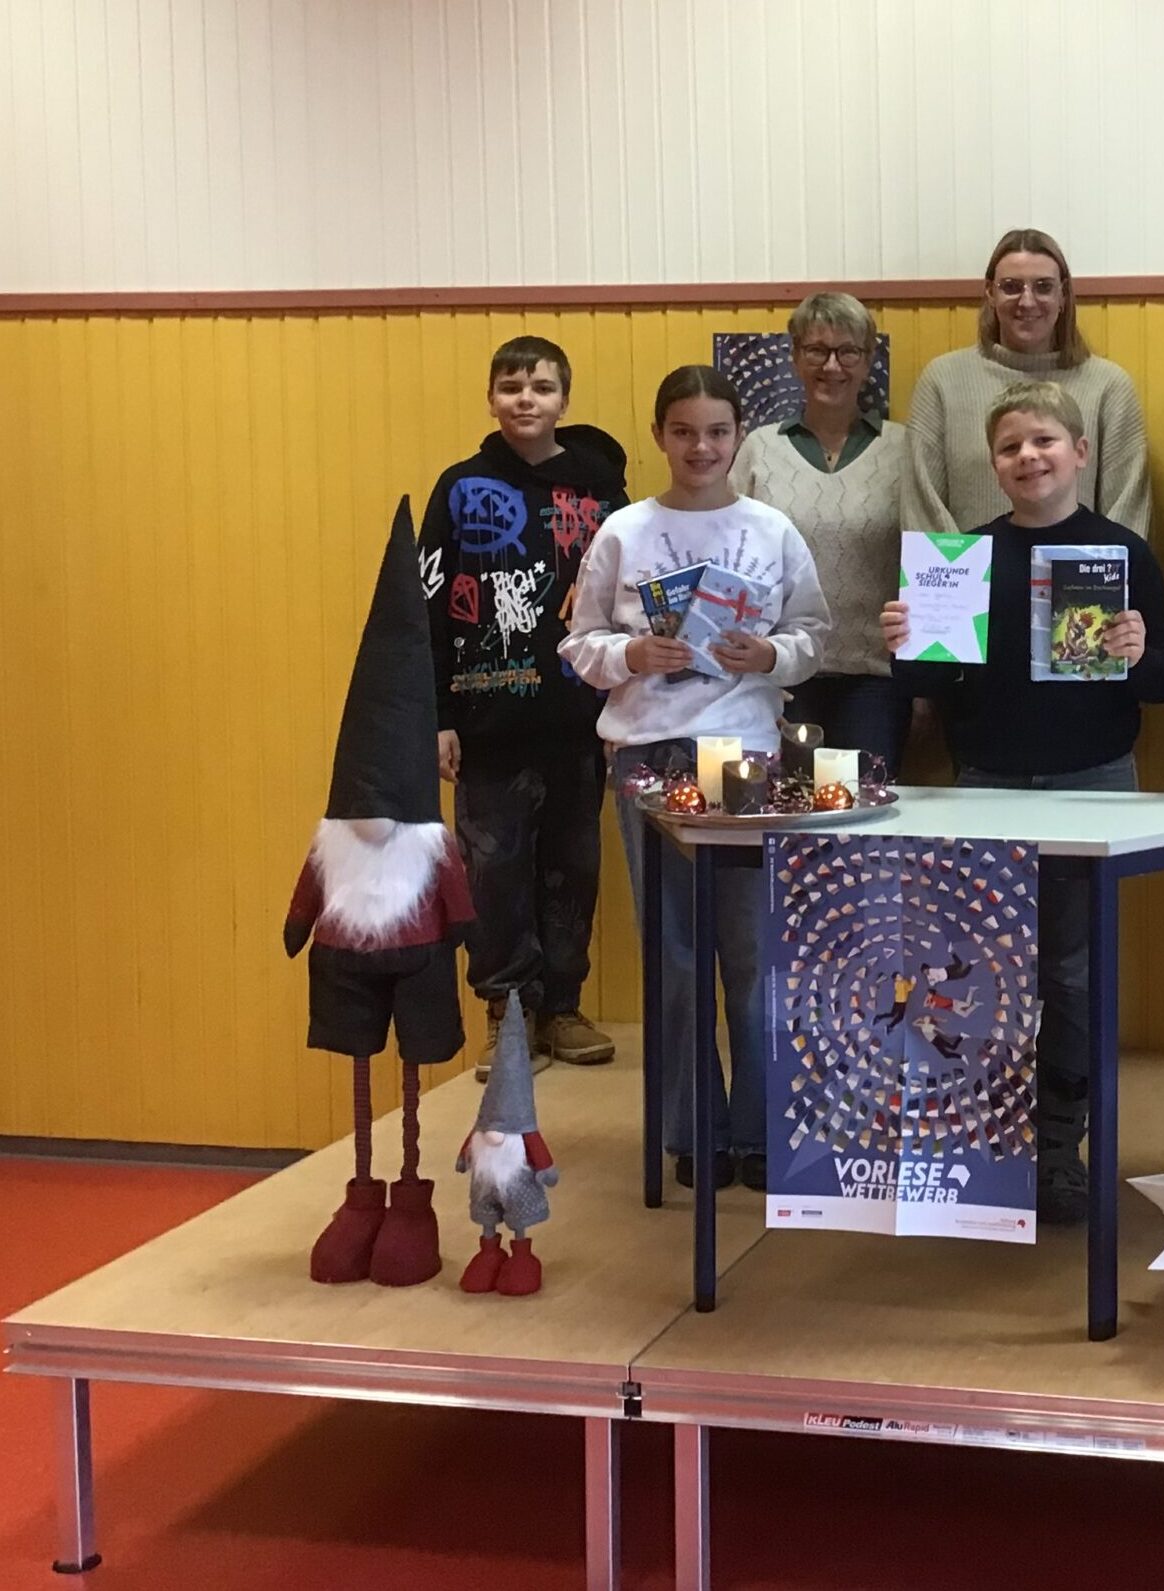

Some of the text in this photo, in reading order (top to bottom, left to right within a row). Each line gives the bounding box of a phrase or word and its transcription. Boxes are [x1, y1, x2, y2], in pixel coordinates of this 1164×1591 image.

[928, 566, 970, 576] URKUNDE
[1079, 563, 1091, 573] Die
[1092, 563, 1106, 573] drei
[915, 572, 942, 581] SCHUL
[1103, 572, 1120, 584] Kids
[834, 1157, 945, 1187] VORLESE
[840, 1181, 960, 1205] WETTBEWERB
[808, 1413, 841, 1427] KLEU
[843, 1416, 880, 1430] Podest
